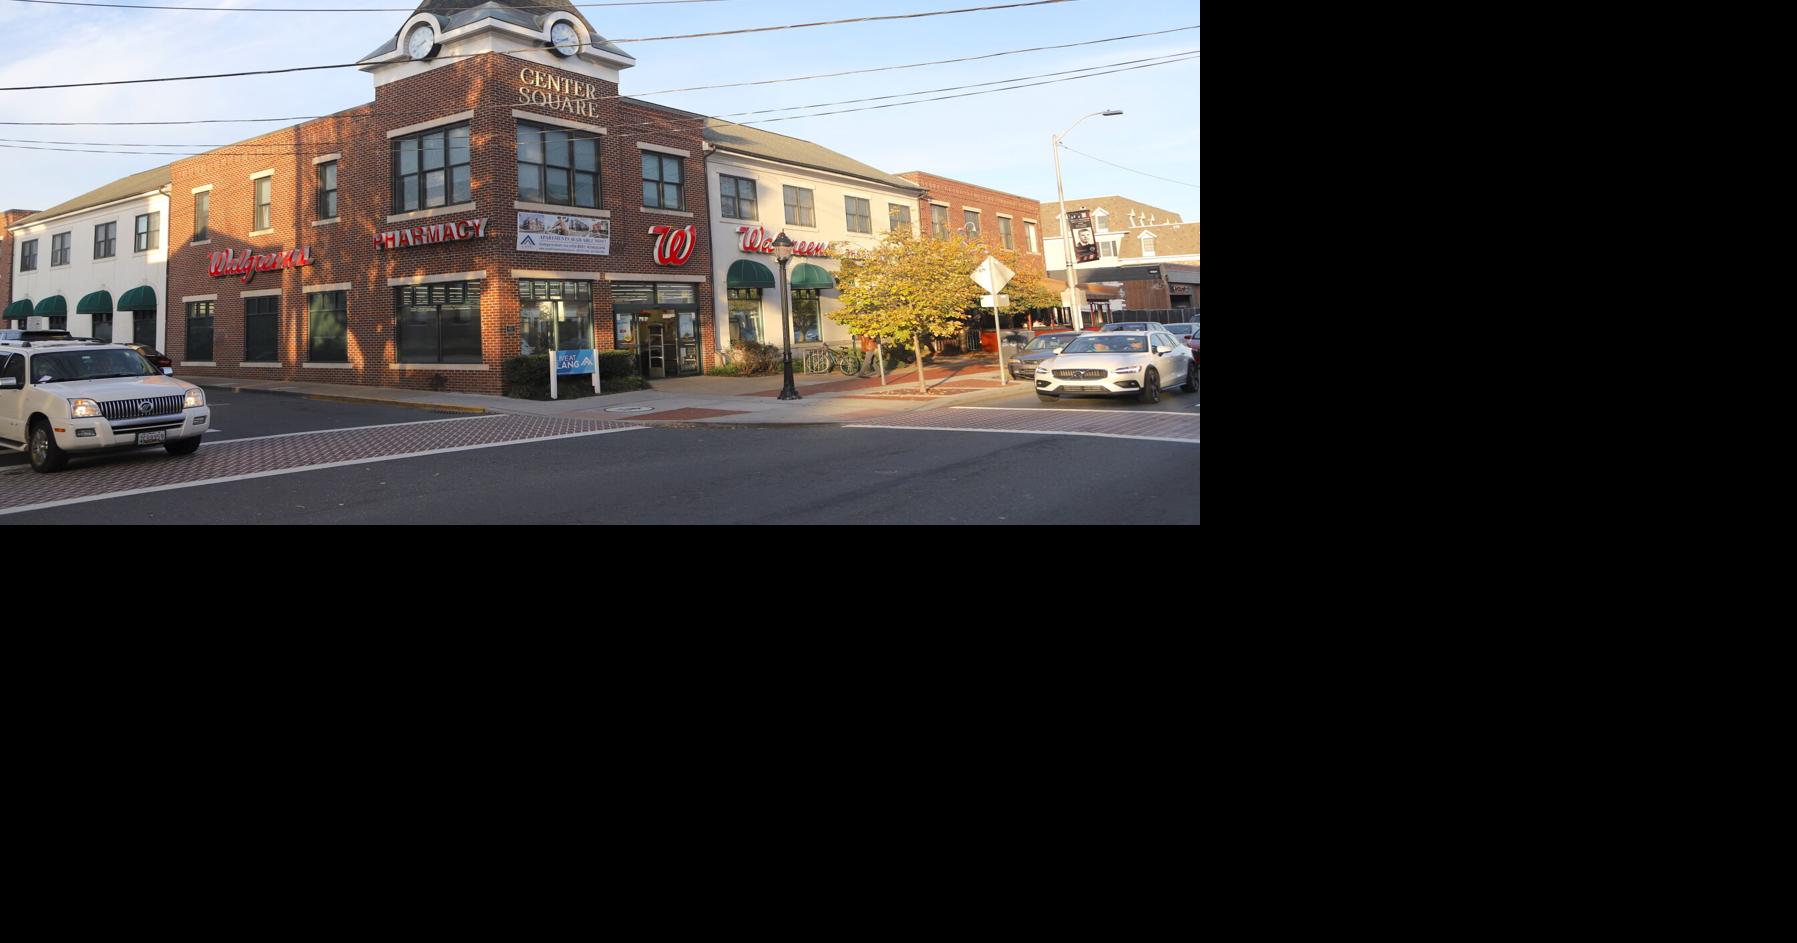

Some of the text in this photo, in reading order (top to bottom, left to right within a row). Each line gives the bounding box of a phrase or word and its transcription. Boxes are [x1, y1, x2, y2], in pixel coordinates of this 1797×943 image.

[520, 67, 596, 99] CENTER
[518, 86, 599, 119] SQUARE
[373, 218, 487, 250] PHARMACY
[648, 224, 697, 267] W
[208, 247, 313, 283] Walgreens
